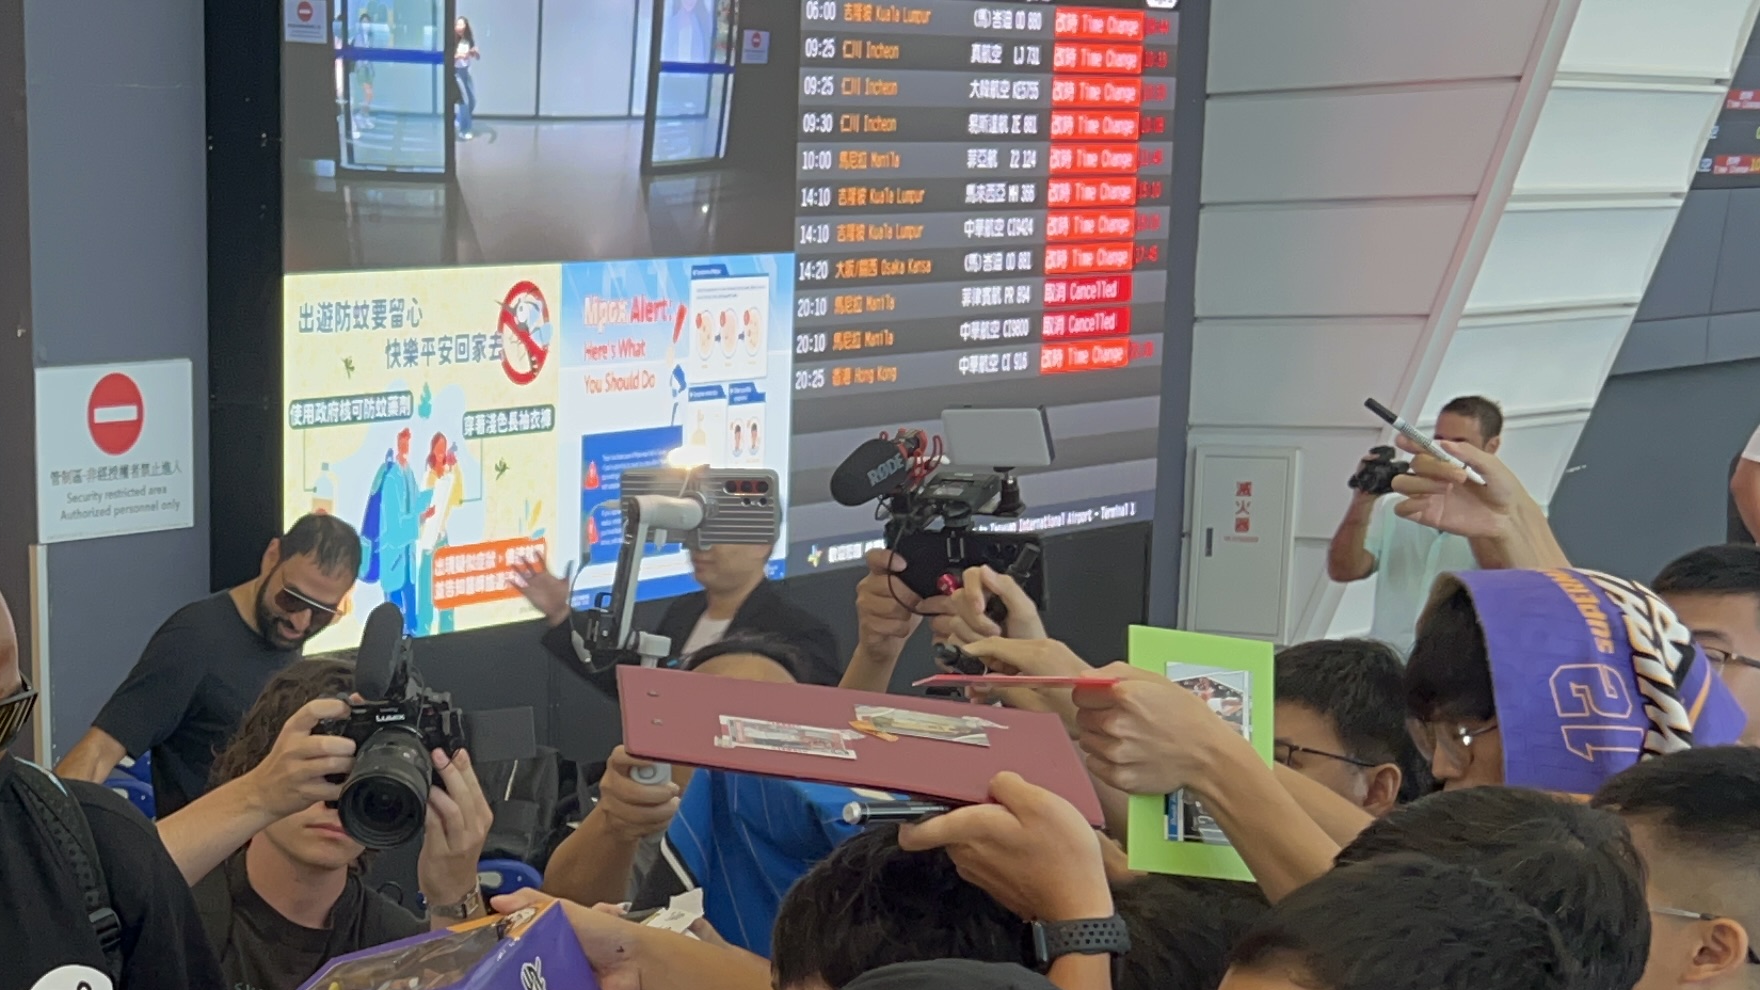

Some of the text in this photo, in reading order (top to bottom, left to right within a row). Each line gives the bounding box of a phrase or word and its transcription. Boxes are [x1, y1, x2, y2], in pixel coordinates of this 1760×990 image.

[806, 1, 836, 20] 06:00
[805, 38, 835, 58] 09:25
[804, 75, 834, 95] 09:25
[802, 113, 833, 133] 09:30
[802, 150, 832, 170] 10:00
[801, 187, 831, 207] 14:10
[800, 224, 830, 244] 14:10
[799, 260, 828, 281] 14:20
[797, 297, 827, 317] 20:10
[1070, 280, 1118, 301] Cancelled
[298, 297, 423, 334] 出遊防蚊要留心
[584, 295, 629, 334] Mpox
[796, 333, 826, 353] 20:10
[1068, 312, 1116, 334] Cancelled
[385, 331, 504, 370] 快樂平安回家去
[584, 338, 646, 362] Here's What
[584, 369, 656, 394] You Should Do
[795, 368, 825, 390] 20:25
[867, 453, 905, 487] RØDE
[67, 485, 167, 504] Security restricted area
[60, 499, 181, 521] Authorized personnel only
[1101, 502, 1128, 520] Terminal
[375, 713, 406, 722] LUMIX
[1549, 663, 1644, 762] 12
